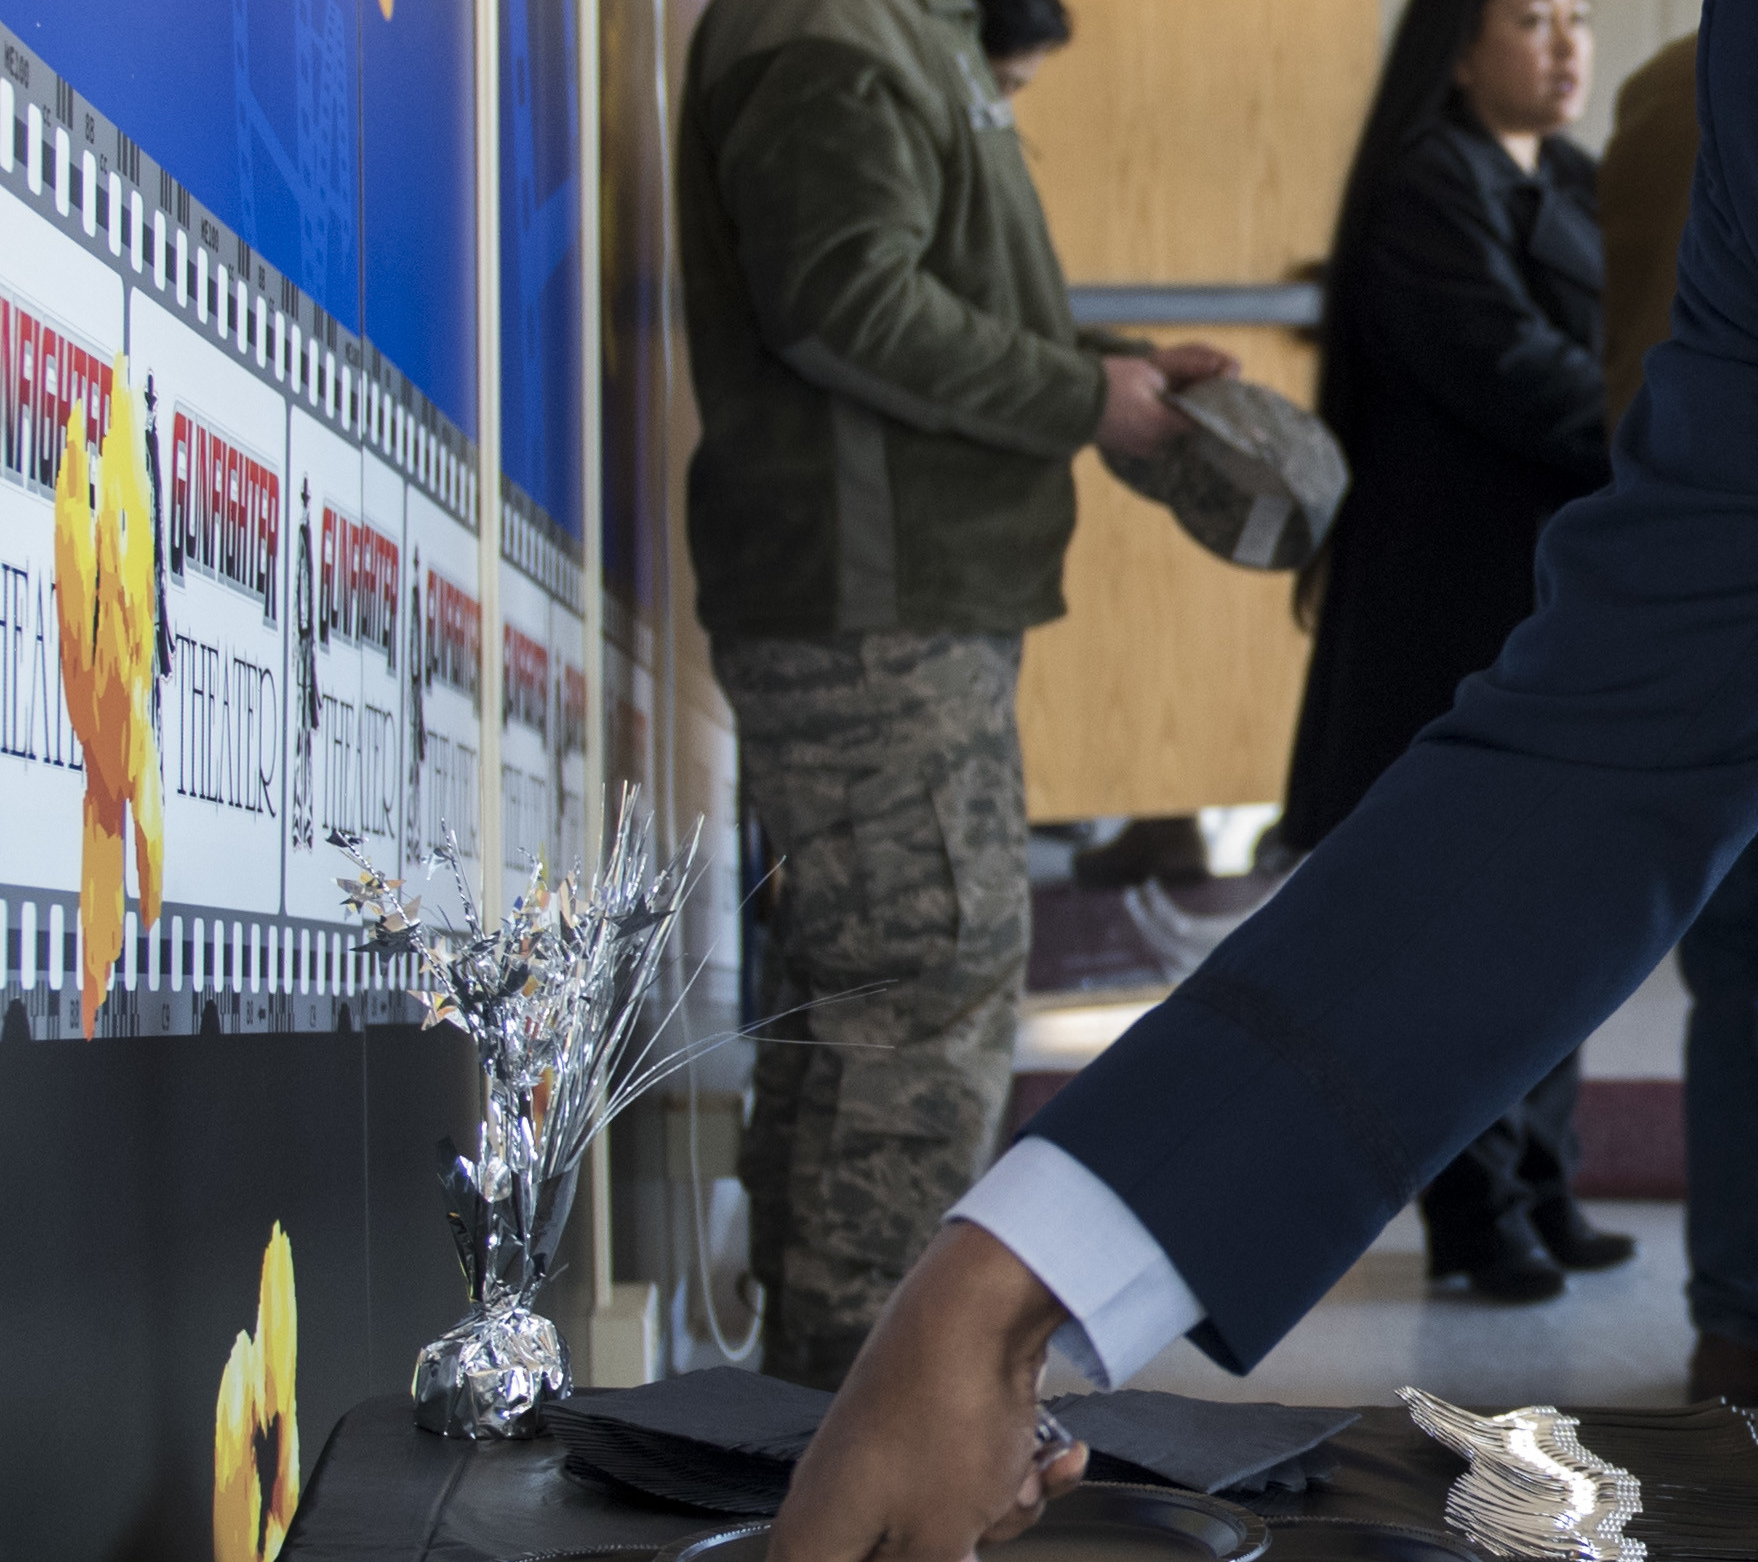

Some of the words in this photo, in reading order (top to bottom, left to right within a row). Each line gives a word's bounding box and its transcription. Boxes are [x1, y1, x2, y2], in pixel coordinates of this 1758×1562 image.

[170, 406, 280, 628] GUNFIGHTER
[319, 504, 399, 675] GUNFIGHTER
[174, 628, 277, 821] THEATER
[322, 691, 396, 839] THEATER
